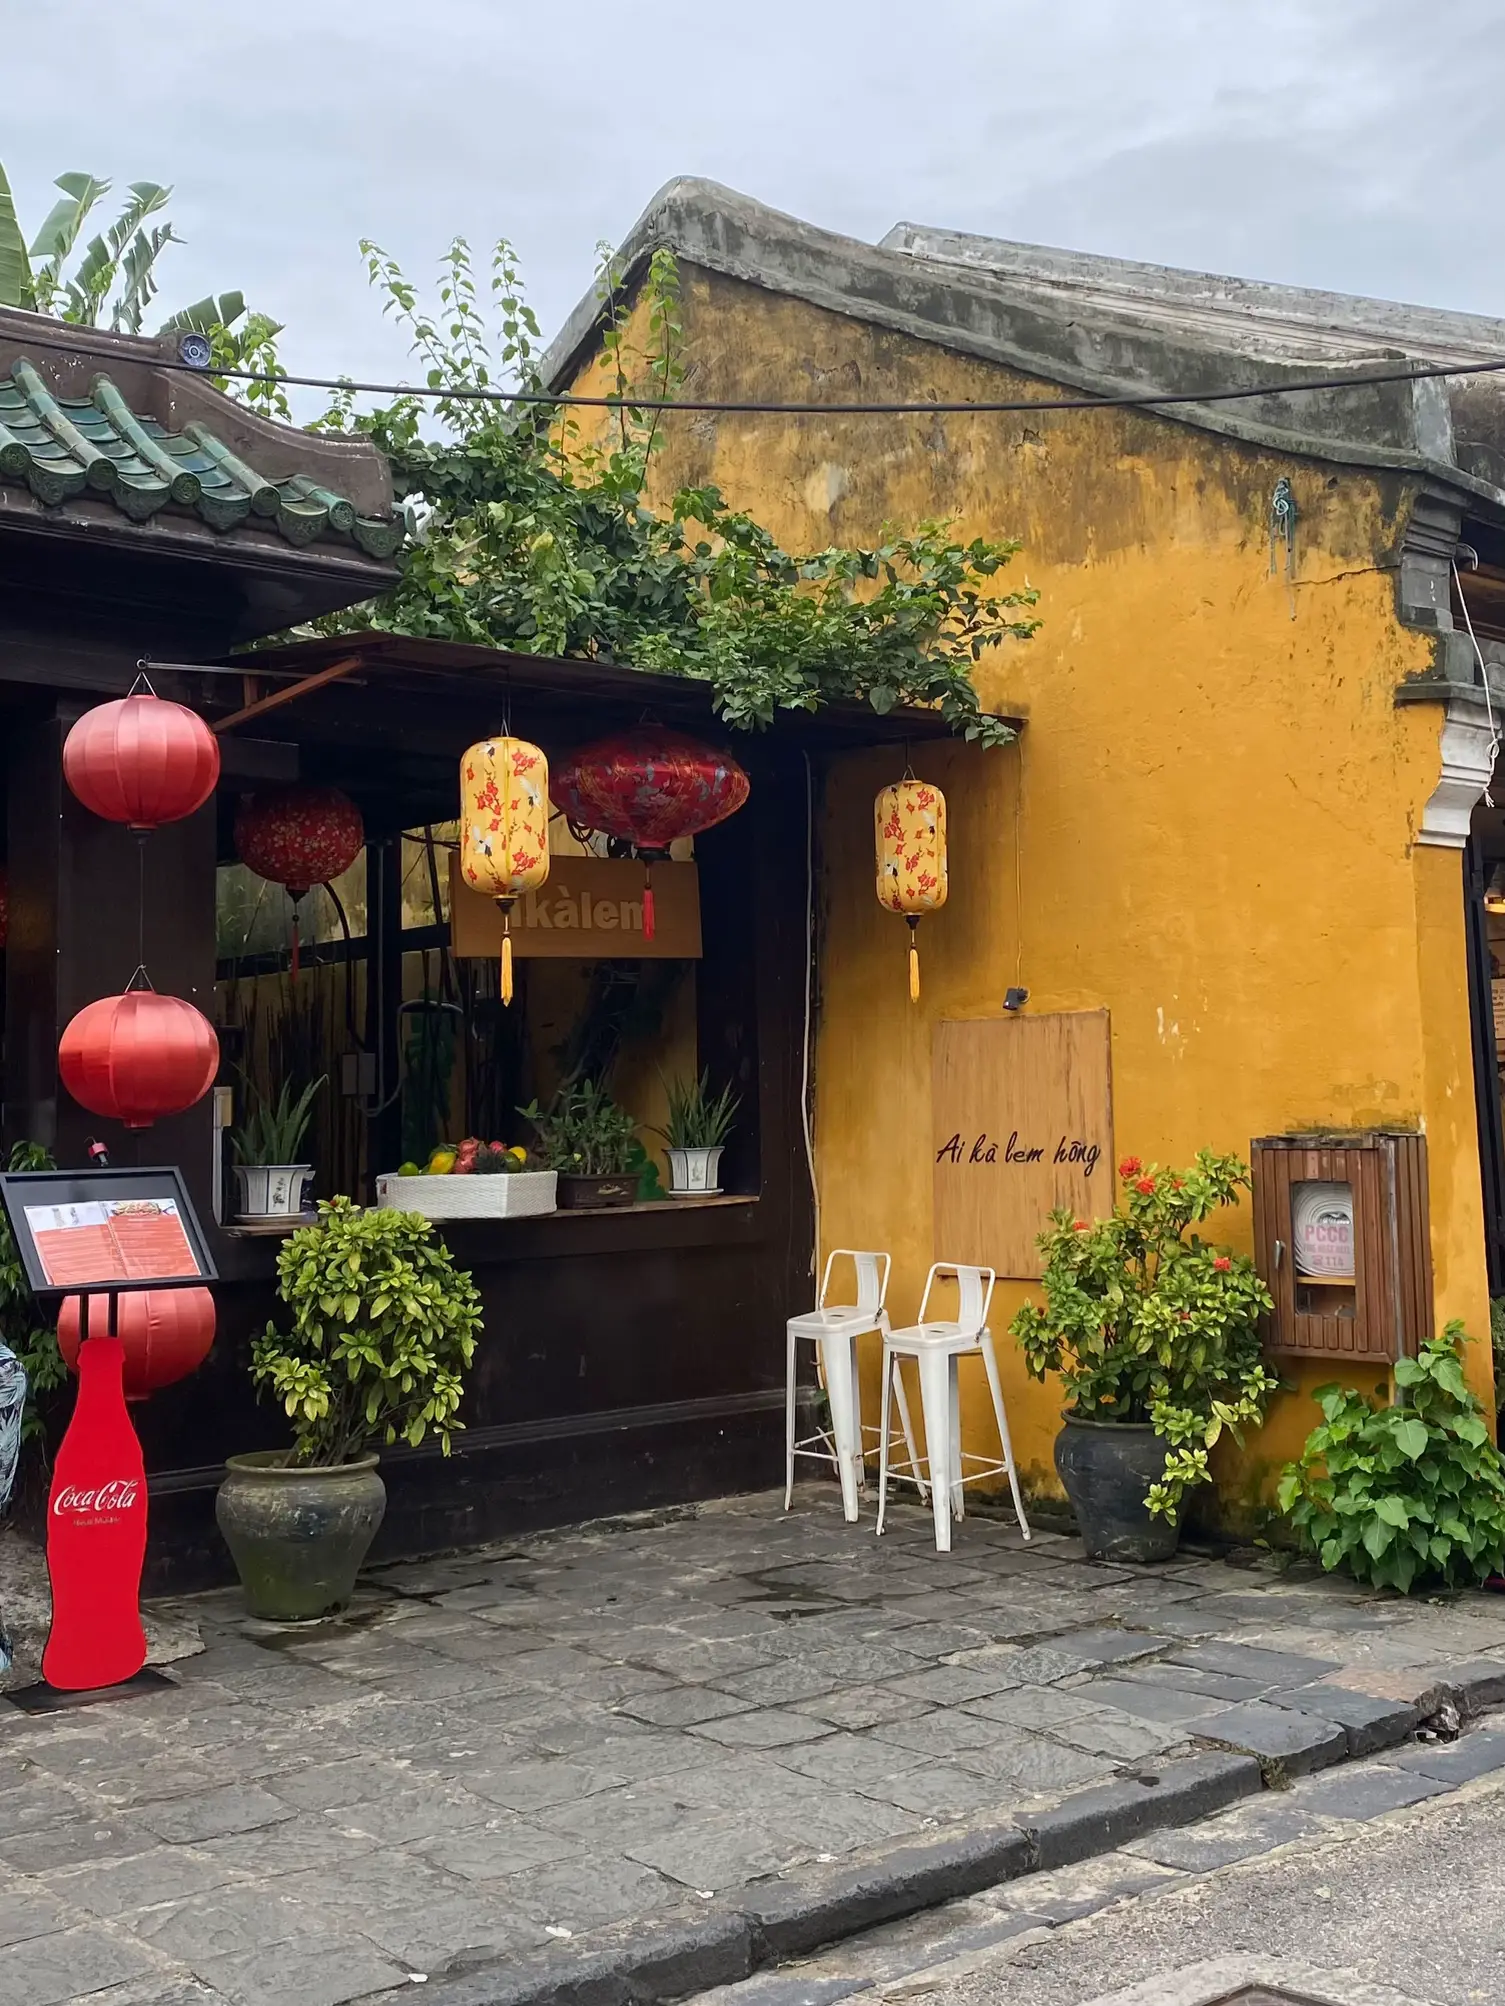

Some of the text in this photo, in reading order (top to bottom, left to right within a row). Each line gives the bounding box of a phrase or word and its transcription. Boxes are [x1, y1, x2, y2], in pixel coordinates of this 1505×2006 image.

[936, 1133, 966, 1163] Ai
[969, 1133, 999, 1163] kà
[1005, 1131, 1044, 1163] lem
[1305, 1224, 1349, 1243] PCCC
